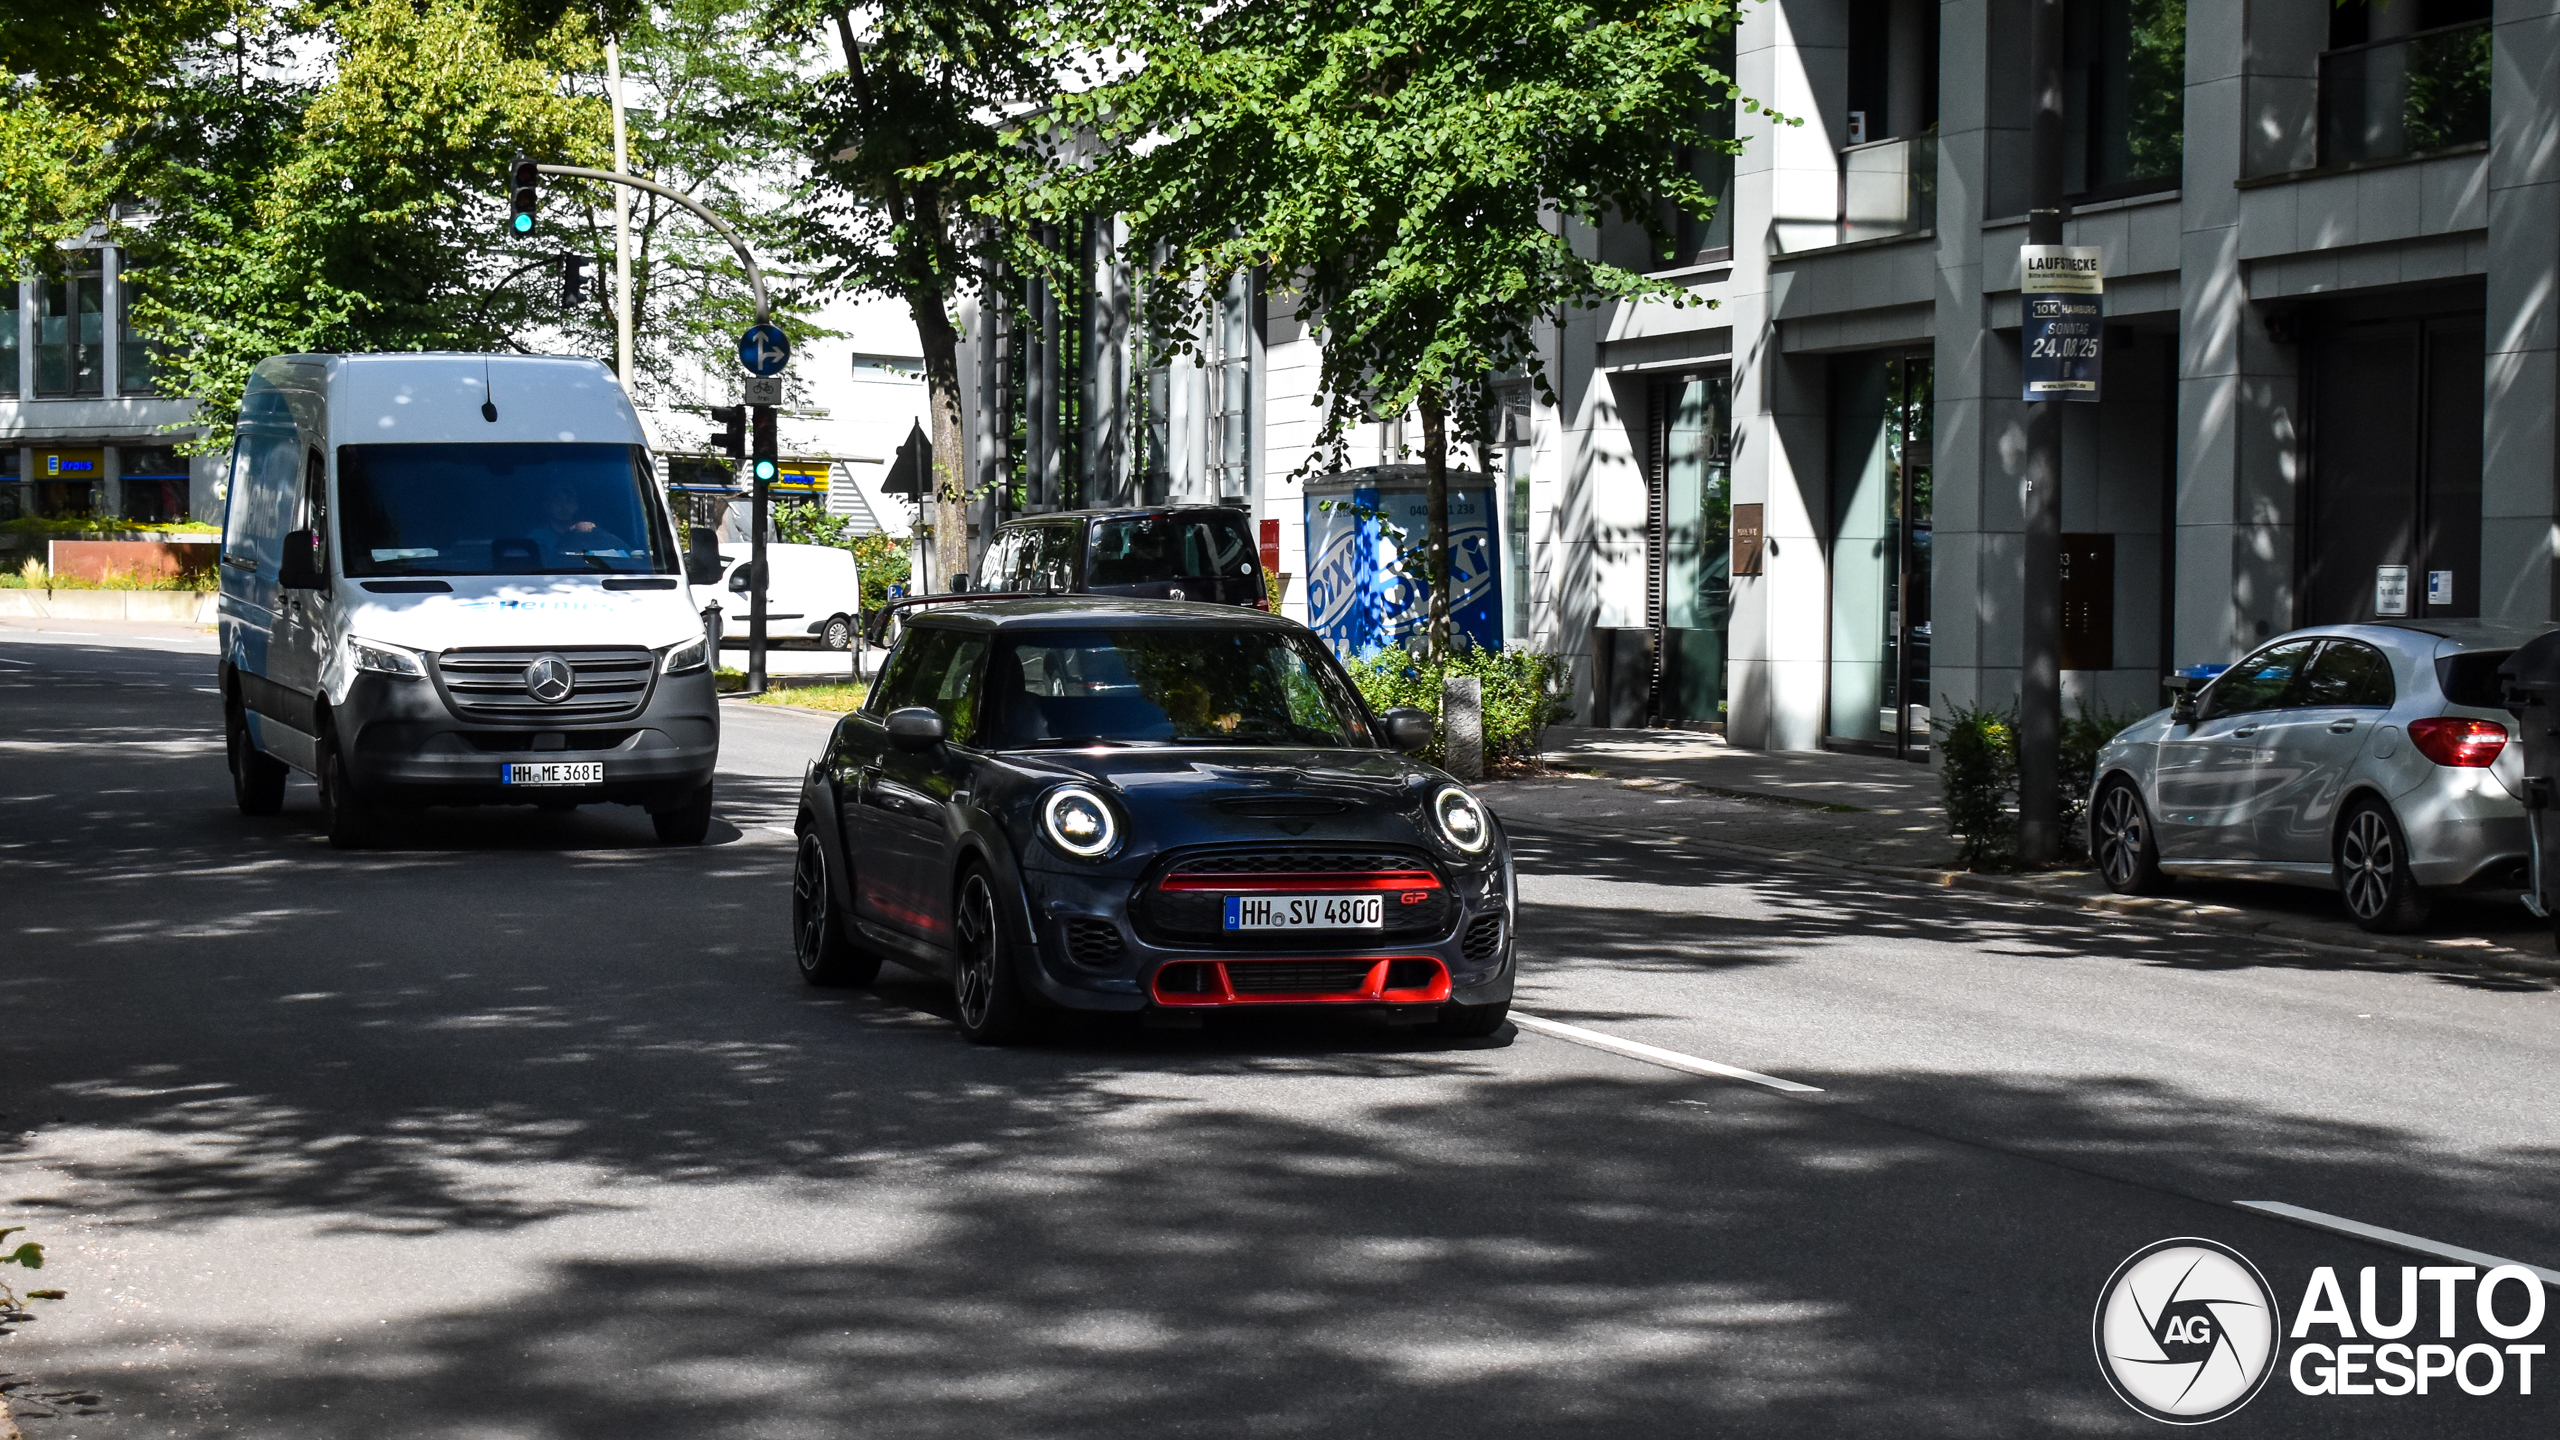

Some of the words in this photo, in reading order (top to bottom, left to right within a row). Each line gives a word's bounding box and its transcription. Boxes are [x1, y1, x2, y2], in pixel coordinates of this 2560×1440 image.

[2028, 257, 2097, 271] LAUFSTRECKE
[2061, 304, 2097, 314] HAMBURG
[2048, 322, 2090, 335] SONNTAG
[61, 461, 92, 471] Kraus
[1410, 505, 1428, 516] 040
[1457, 503, 1475, 515] 238
[512, 765, 532, 782] HH
[542, 765, 560, 781] ME
[1401, 892, 1428, 905] GP
[1241, 901, 1271, 925] HH
[1289, 899, 1318, 924] SV
[1324, 898, 1380, 924] 4800
